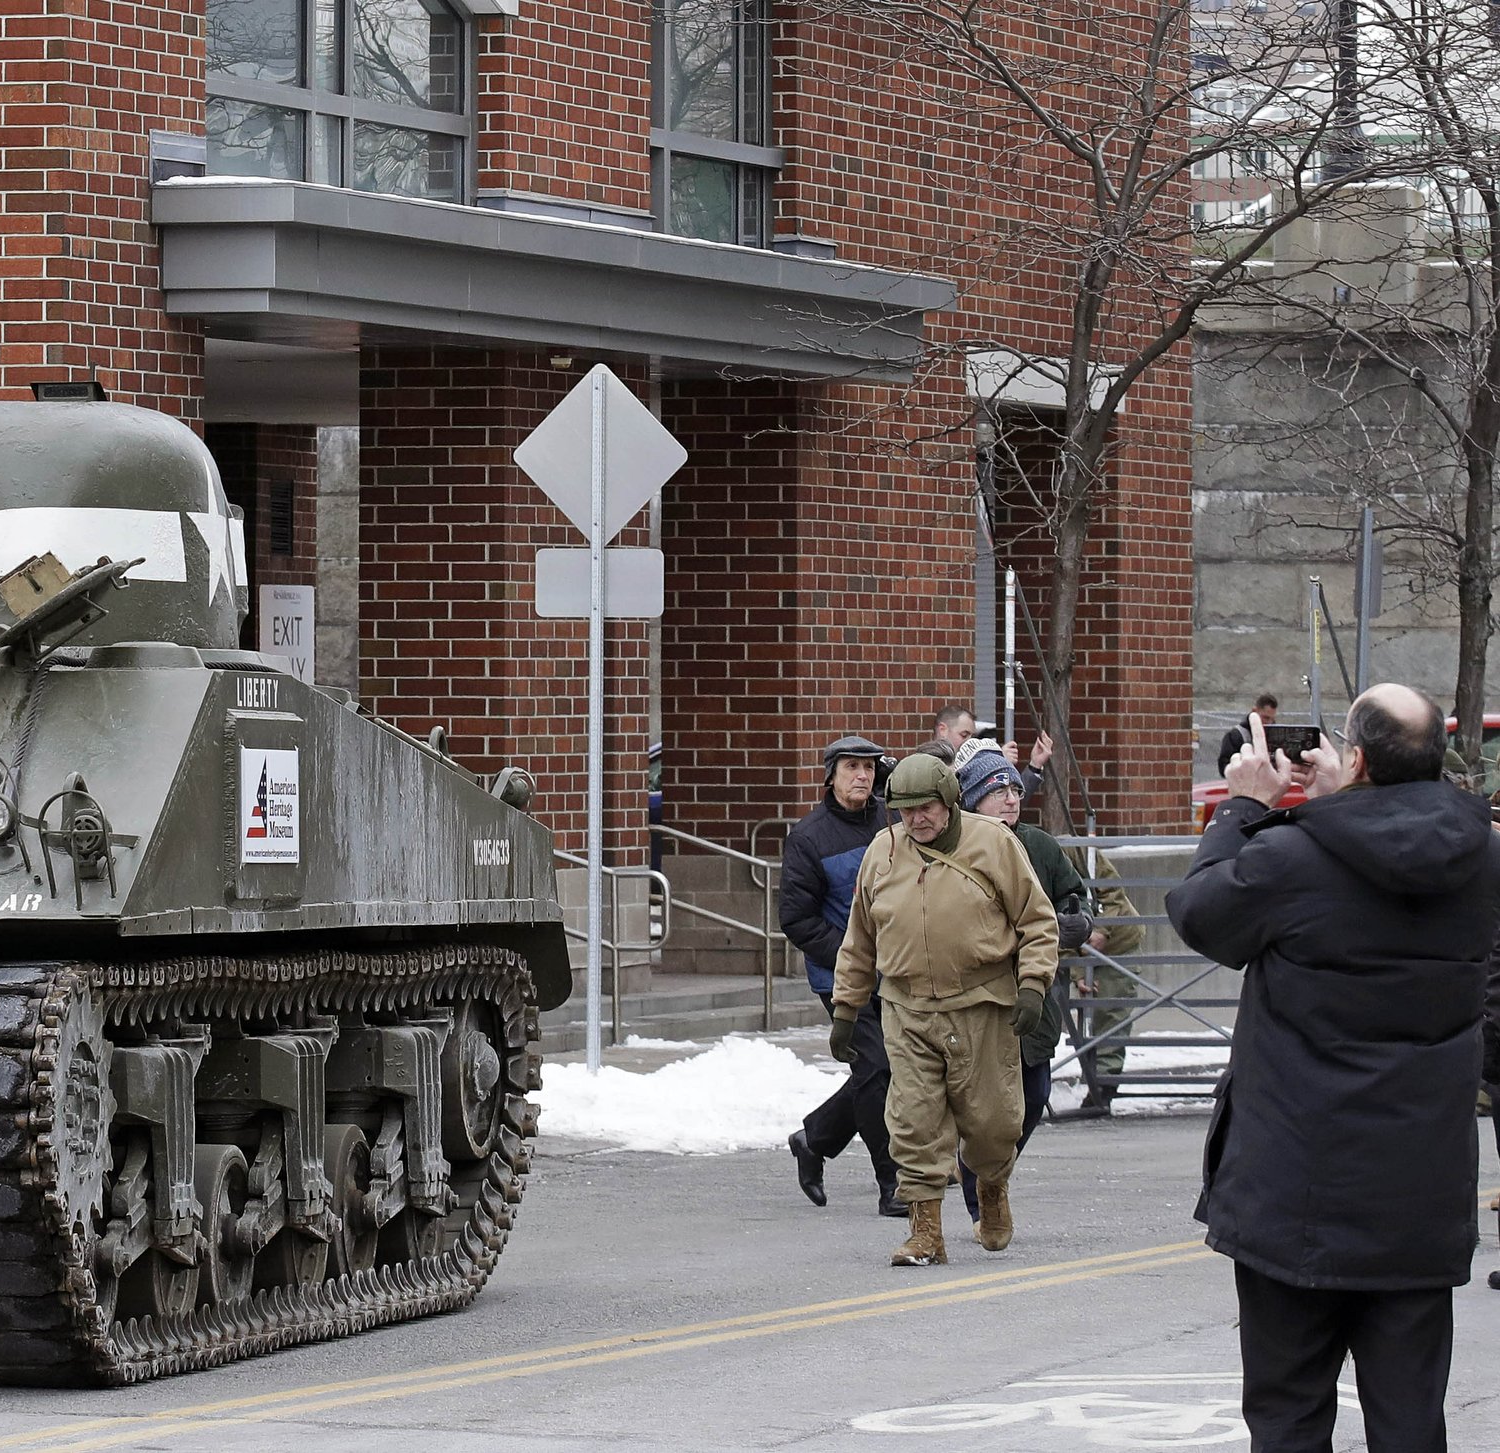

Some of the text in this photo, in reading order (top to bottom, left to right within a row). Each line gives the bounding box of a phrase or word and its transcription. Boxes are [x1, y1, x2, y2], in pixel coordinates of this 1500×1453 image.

[273, 616, 303, 646] EXIT
[236, 677, 279, 708] LIBERTY
[269, 777, 297, 796] American
[269, 799, 293, 821] Heritage
[269, 821, 294, 838] Museum
